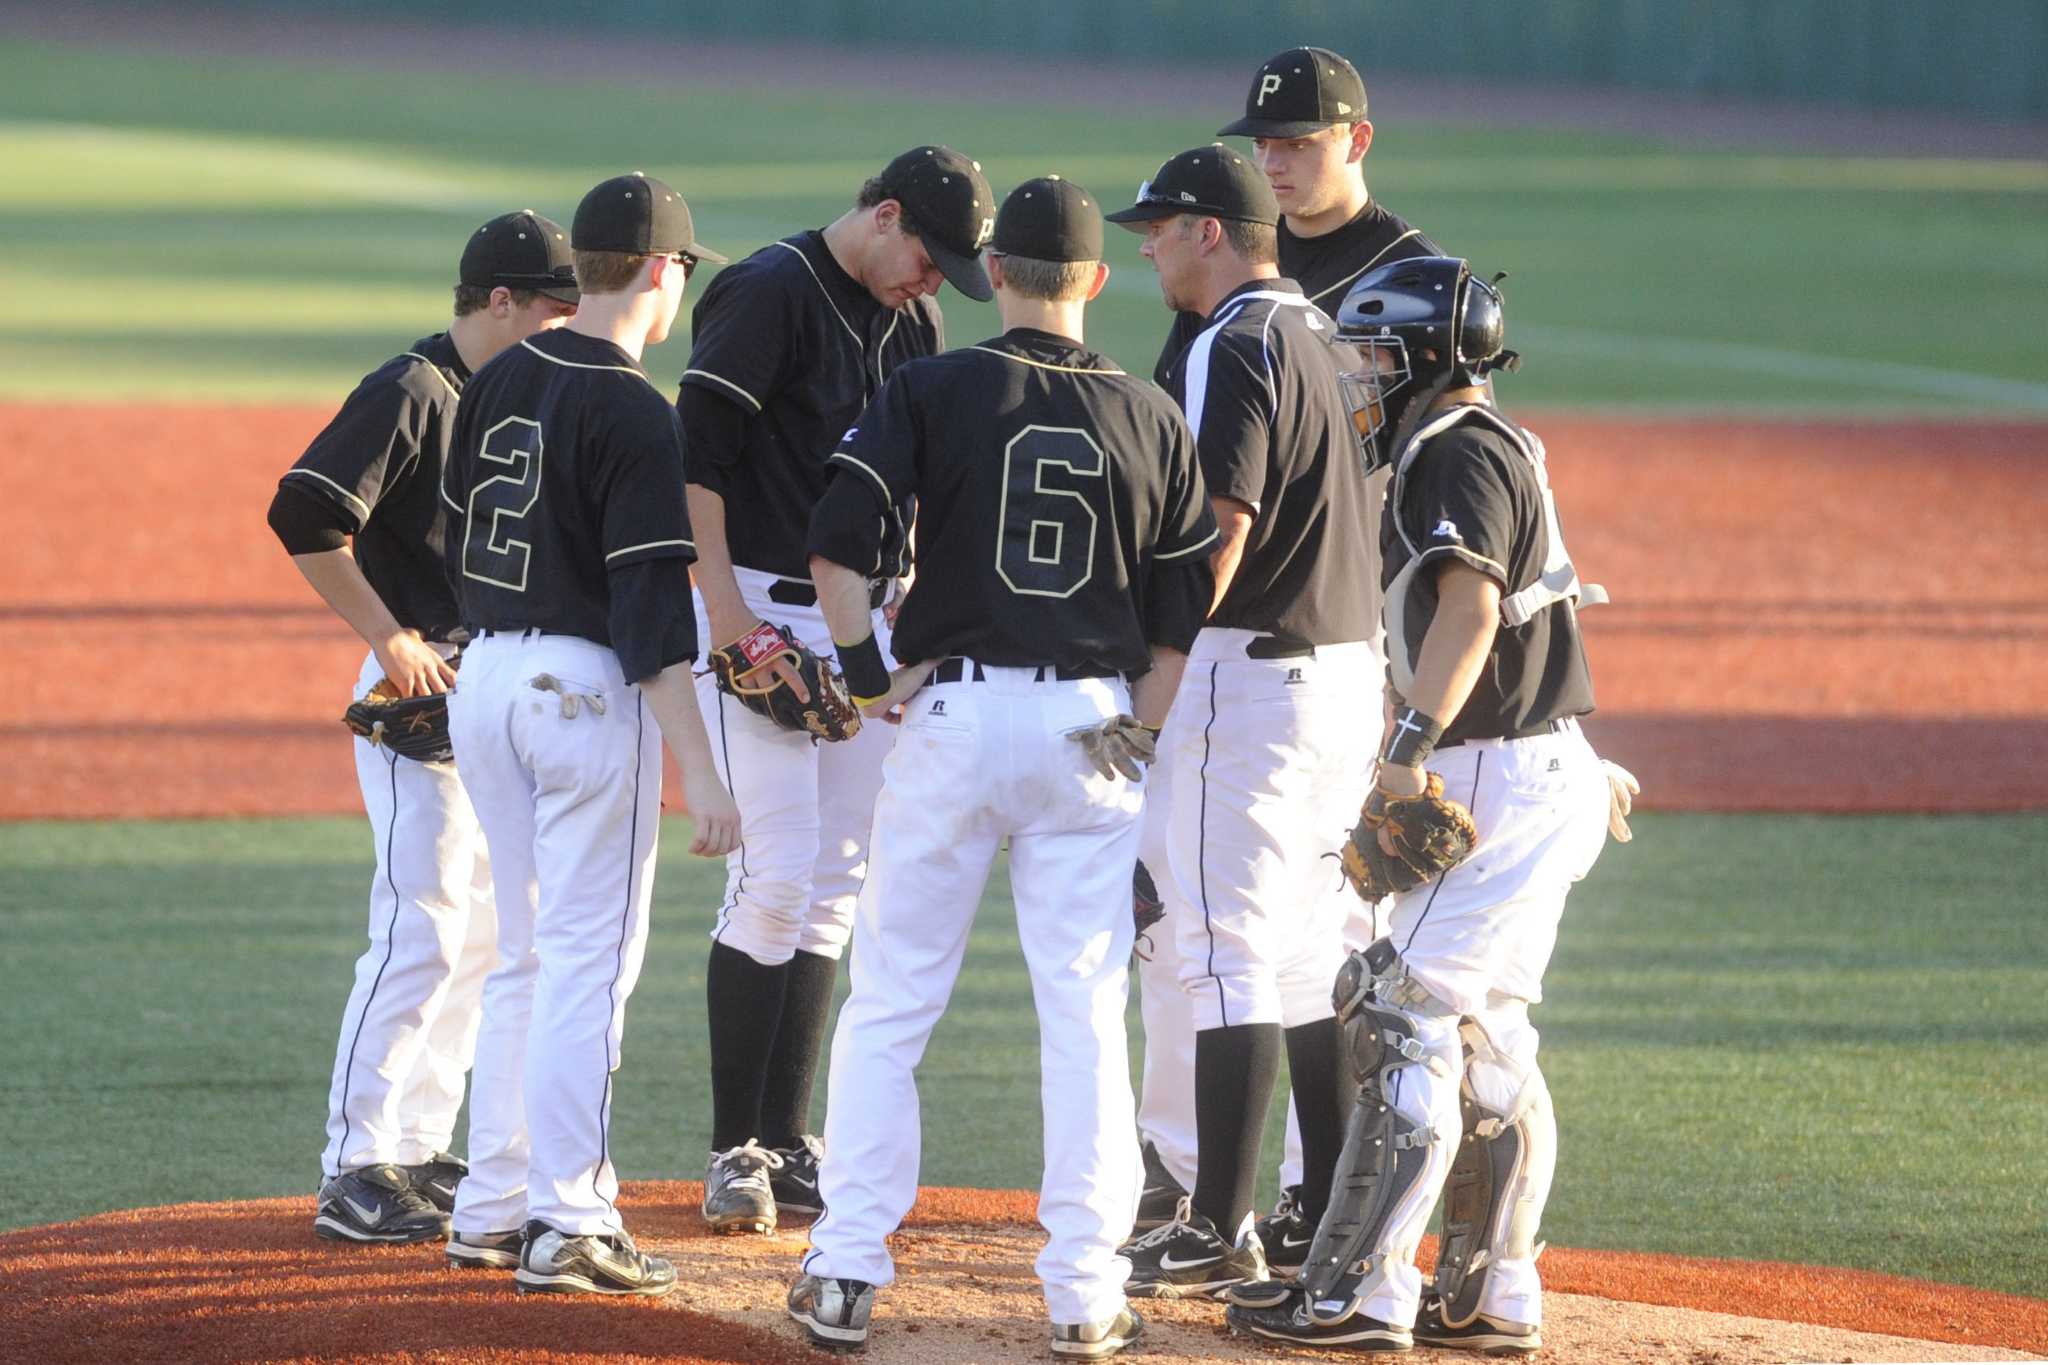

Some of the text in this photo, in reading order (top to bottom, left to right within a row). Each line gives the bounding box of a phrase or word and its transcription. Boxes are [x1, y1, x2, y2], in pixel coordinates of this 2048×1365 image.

[1257, 74, 1282, 106] P
[463, 415, 543, 592] 2
[995, 424, 1103, 599] 6
